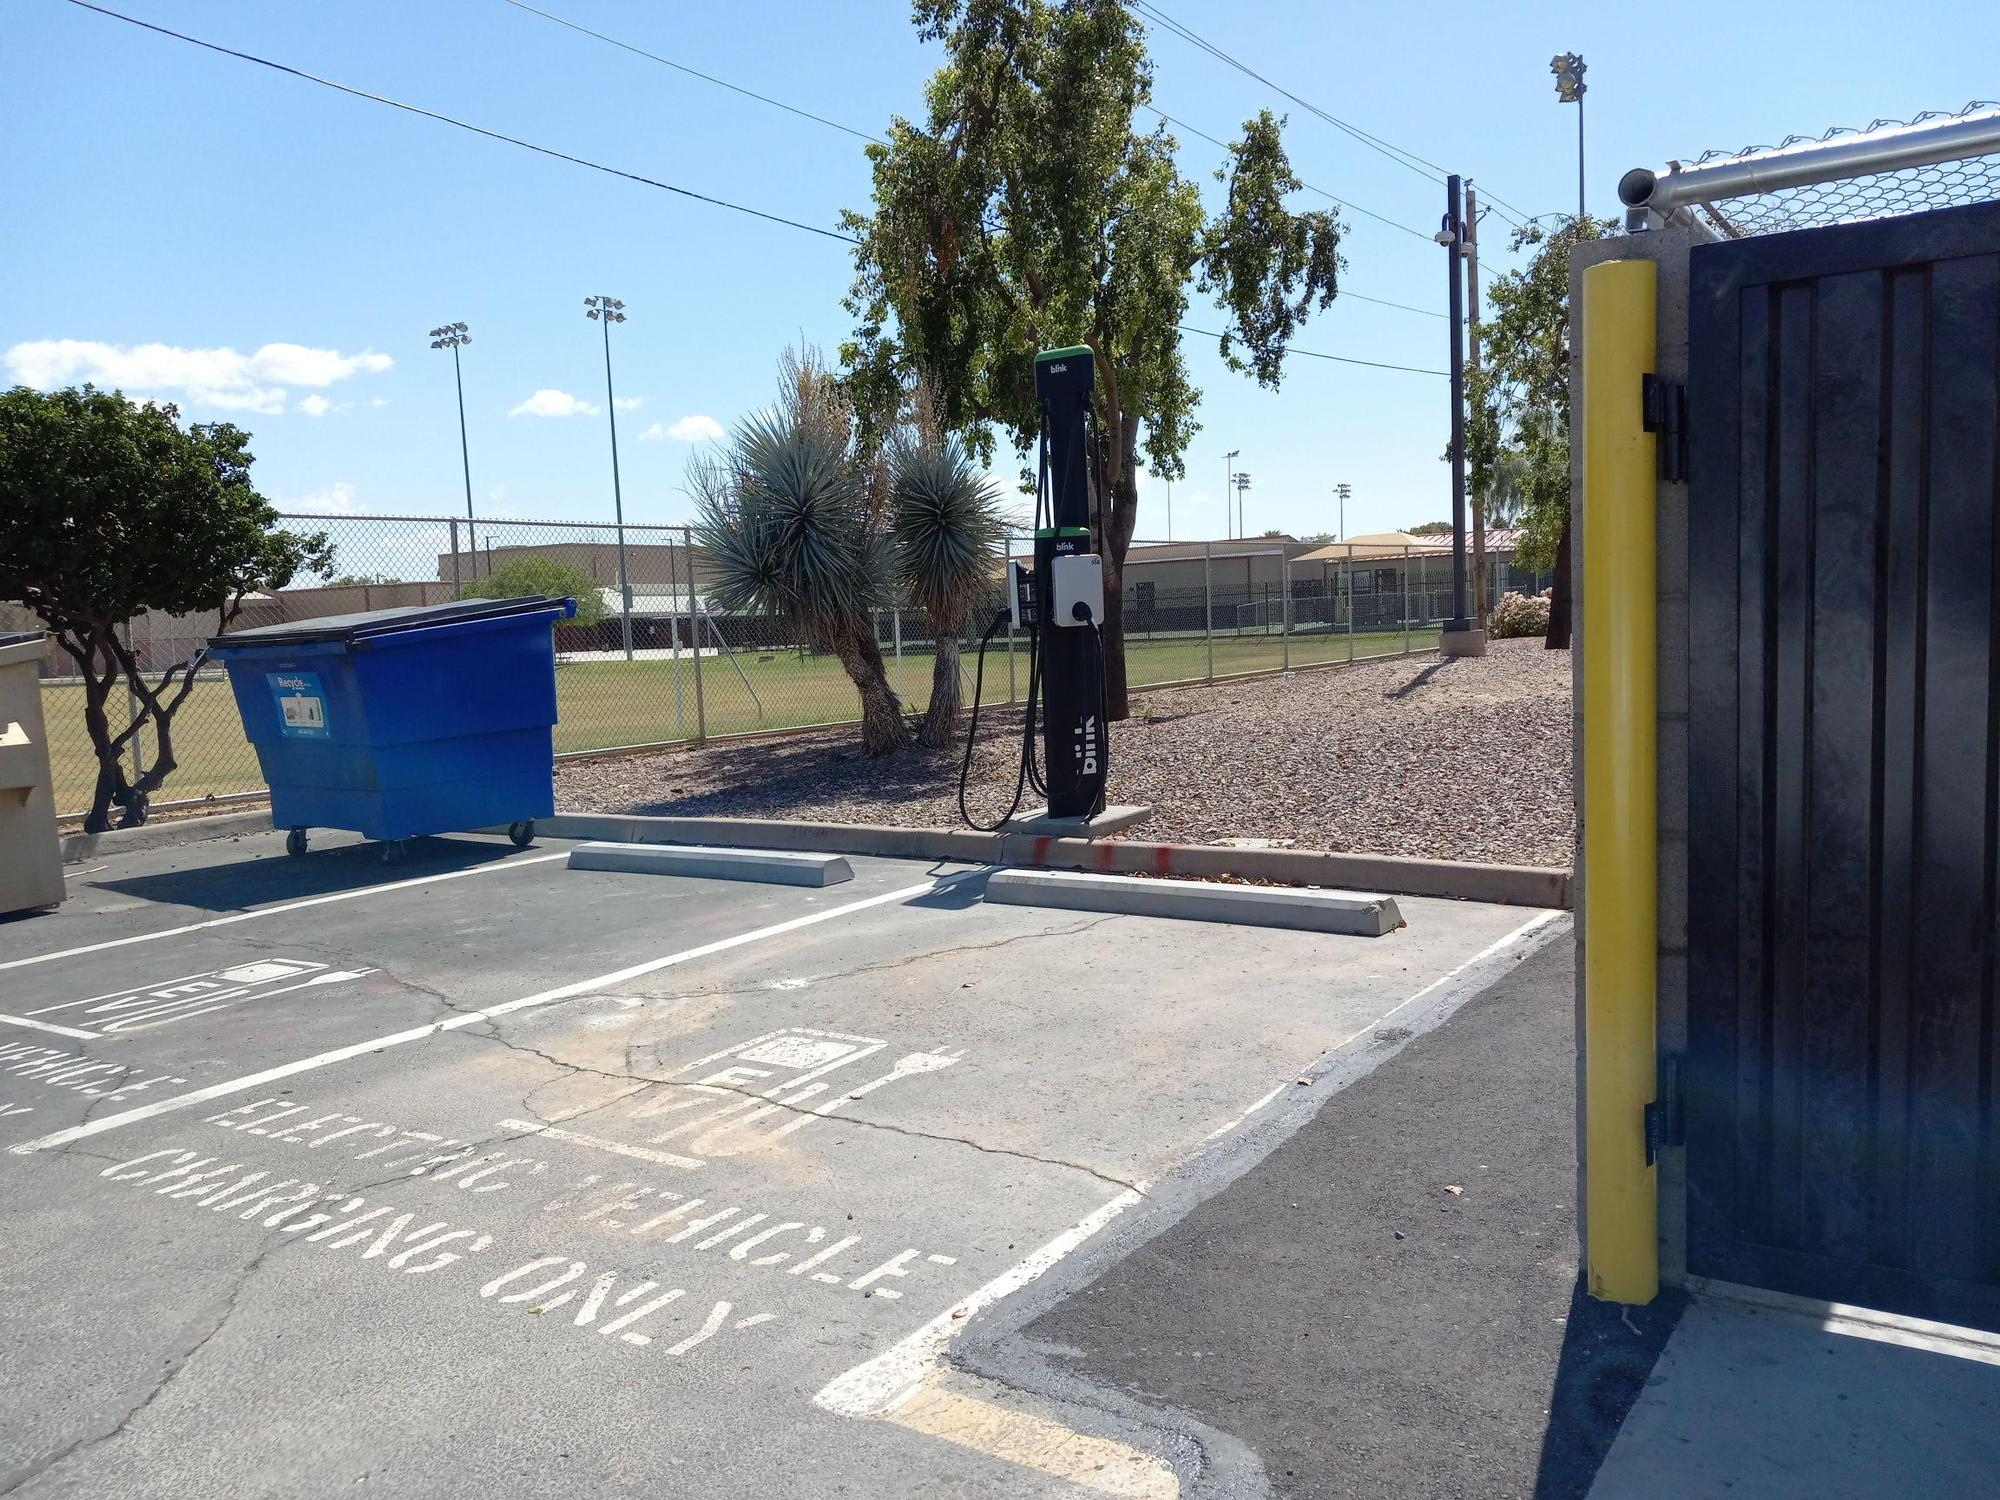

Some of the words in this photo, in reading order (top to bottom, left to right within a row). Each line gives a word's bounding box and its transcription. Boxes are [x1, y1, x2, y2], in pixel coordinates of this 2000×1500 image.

[1050, 364, 1067, 374] blink
[1056, 542, 1074, 551] blink
[277, 676, 304, 690] Recycle
[1074, 715, 1097, 775] blink
[203, 1098, 548, 1193] ELECTRIC
[544, 1174, 958, 1300] VEHICLE
[100, 1148, 493, 1274] CHARGING
[480, 1256, 777, 1356] ONLY
